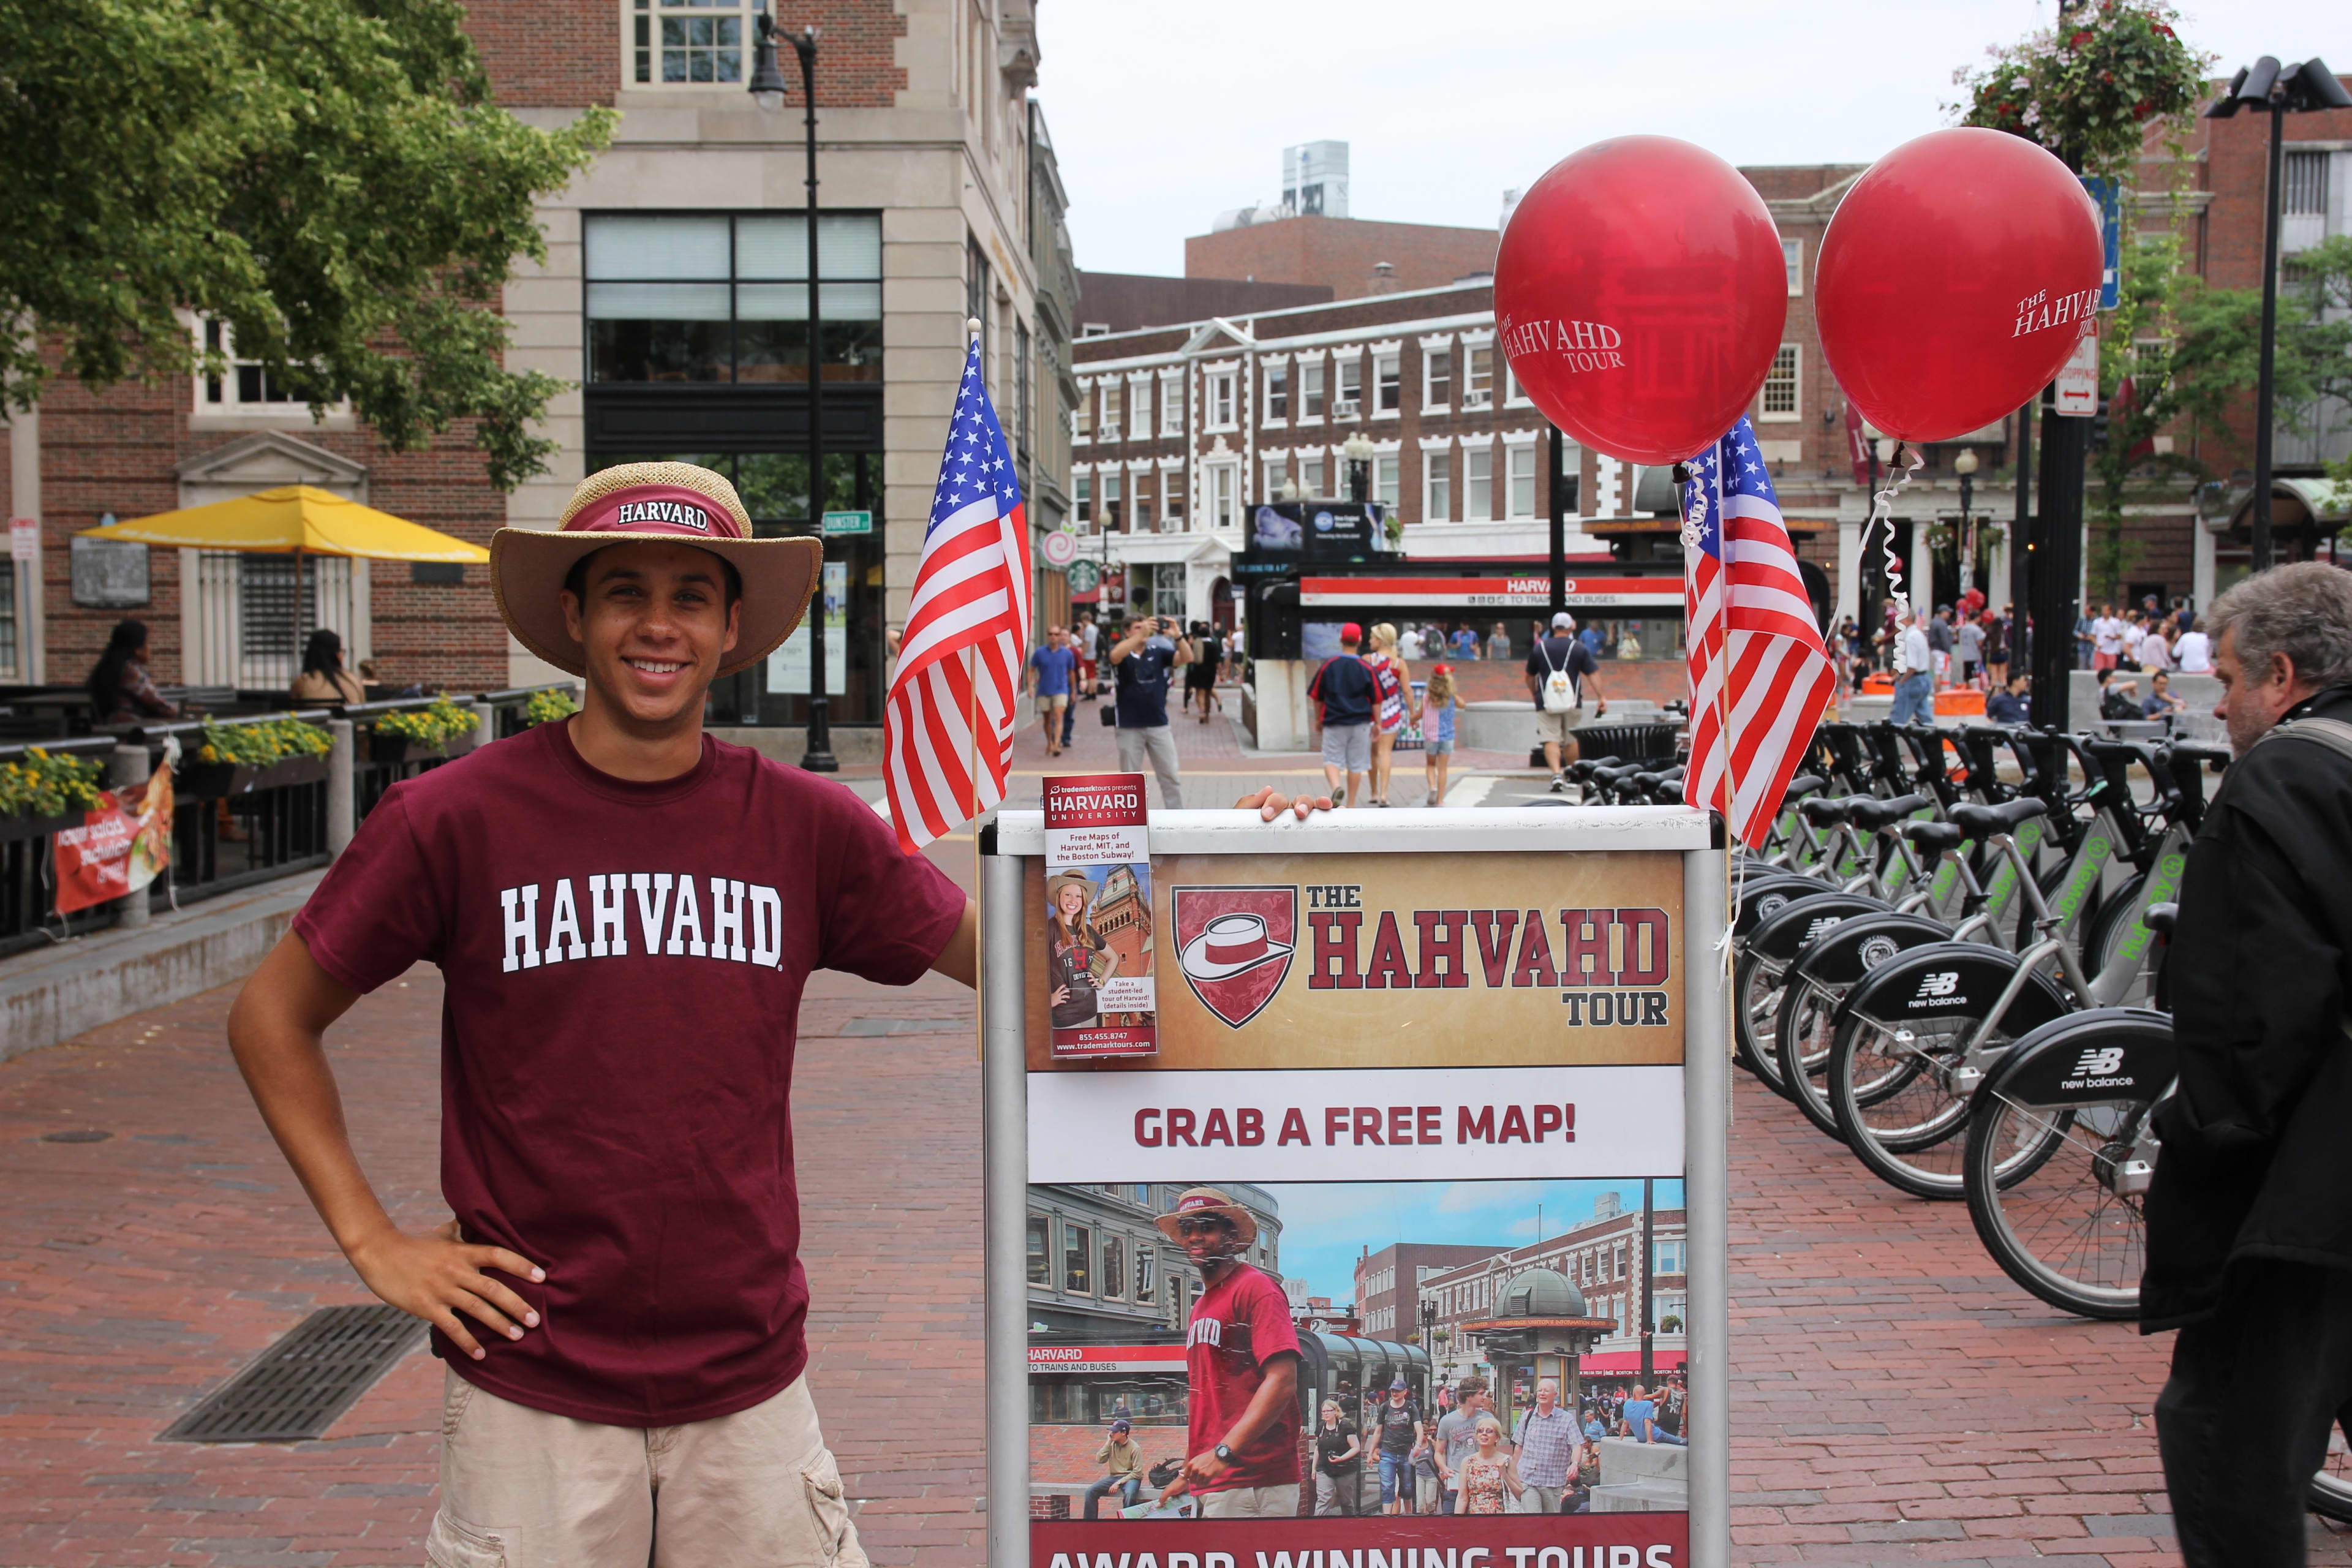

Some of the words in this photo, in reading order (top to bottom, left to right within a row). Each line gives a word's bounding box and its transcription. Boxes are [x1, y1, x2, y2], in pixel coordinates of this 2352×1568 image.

[2017, 288, 2046, 315] THE
[2011, 289, 2101, 337] HAHVAH
[1501, 313, 1512, 336] THE
[1504, 319, 1621, 360] HAHVAHD
[1563, 352, 1626, 373] TOUR
[618, 502, 707, 529] HARVARD
[826, 516, 860, 529] DUNSTER
[1507, 580, 1577, 592] HARVD
[1050, 794, 1138, 812] HARVARD
[1051, 811, 1136, 821] UNIVERSITY
[1089, 833, 1110, 842] Maps
[1101, 851, 1134, 860] Subway!
[1306, 884, 1362, 908] THE
[500, 873, 782, 973] HAHVAHD
[2119, 877, 2174, 960] Hubay
[1307, 908, 1669, 990] HAHVAHD
[1562, 991, 1668, 1027] TOUR
[1908, 1000, 1928, 1008] new
[1928, 997, 1967, 1007] balance
[1057, 1041, 1150, 1050] www.trademarktours.com
[1079, 1032, 1128, 1041] 855.455.8747
[2062, 1080, 2084, 1089] new
[2086, 1077, 2133, 1088] balance
[1134, 1107, 1265, 1147] GRAB
[1277, 1107, 1311, 1146] A
[1325, 1106, 1442, 1145] FREE
[1457, 1104, 1576, 1144] MAP!
[1028, 1349, 1083, 1360] HARVARD
